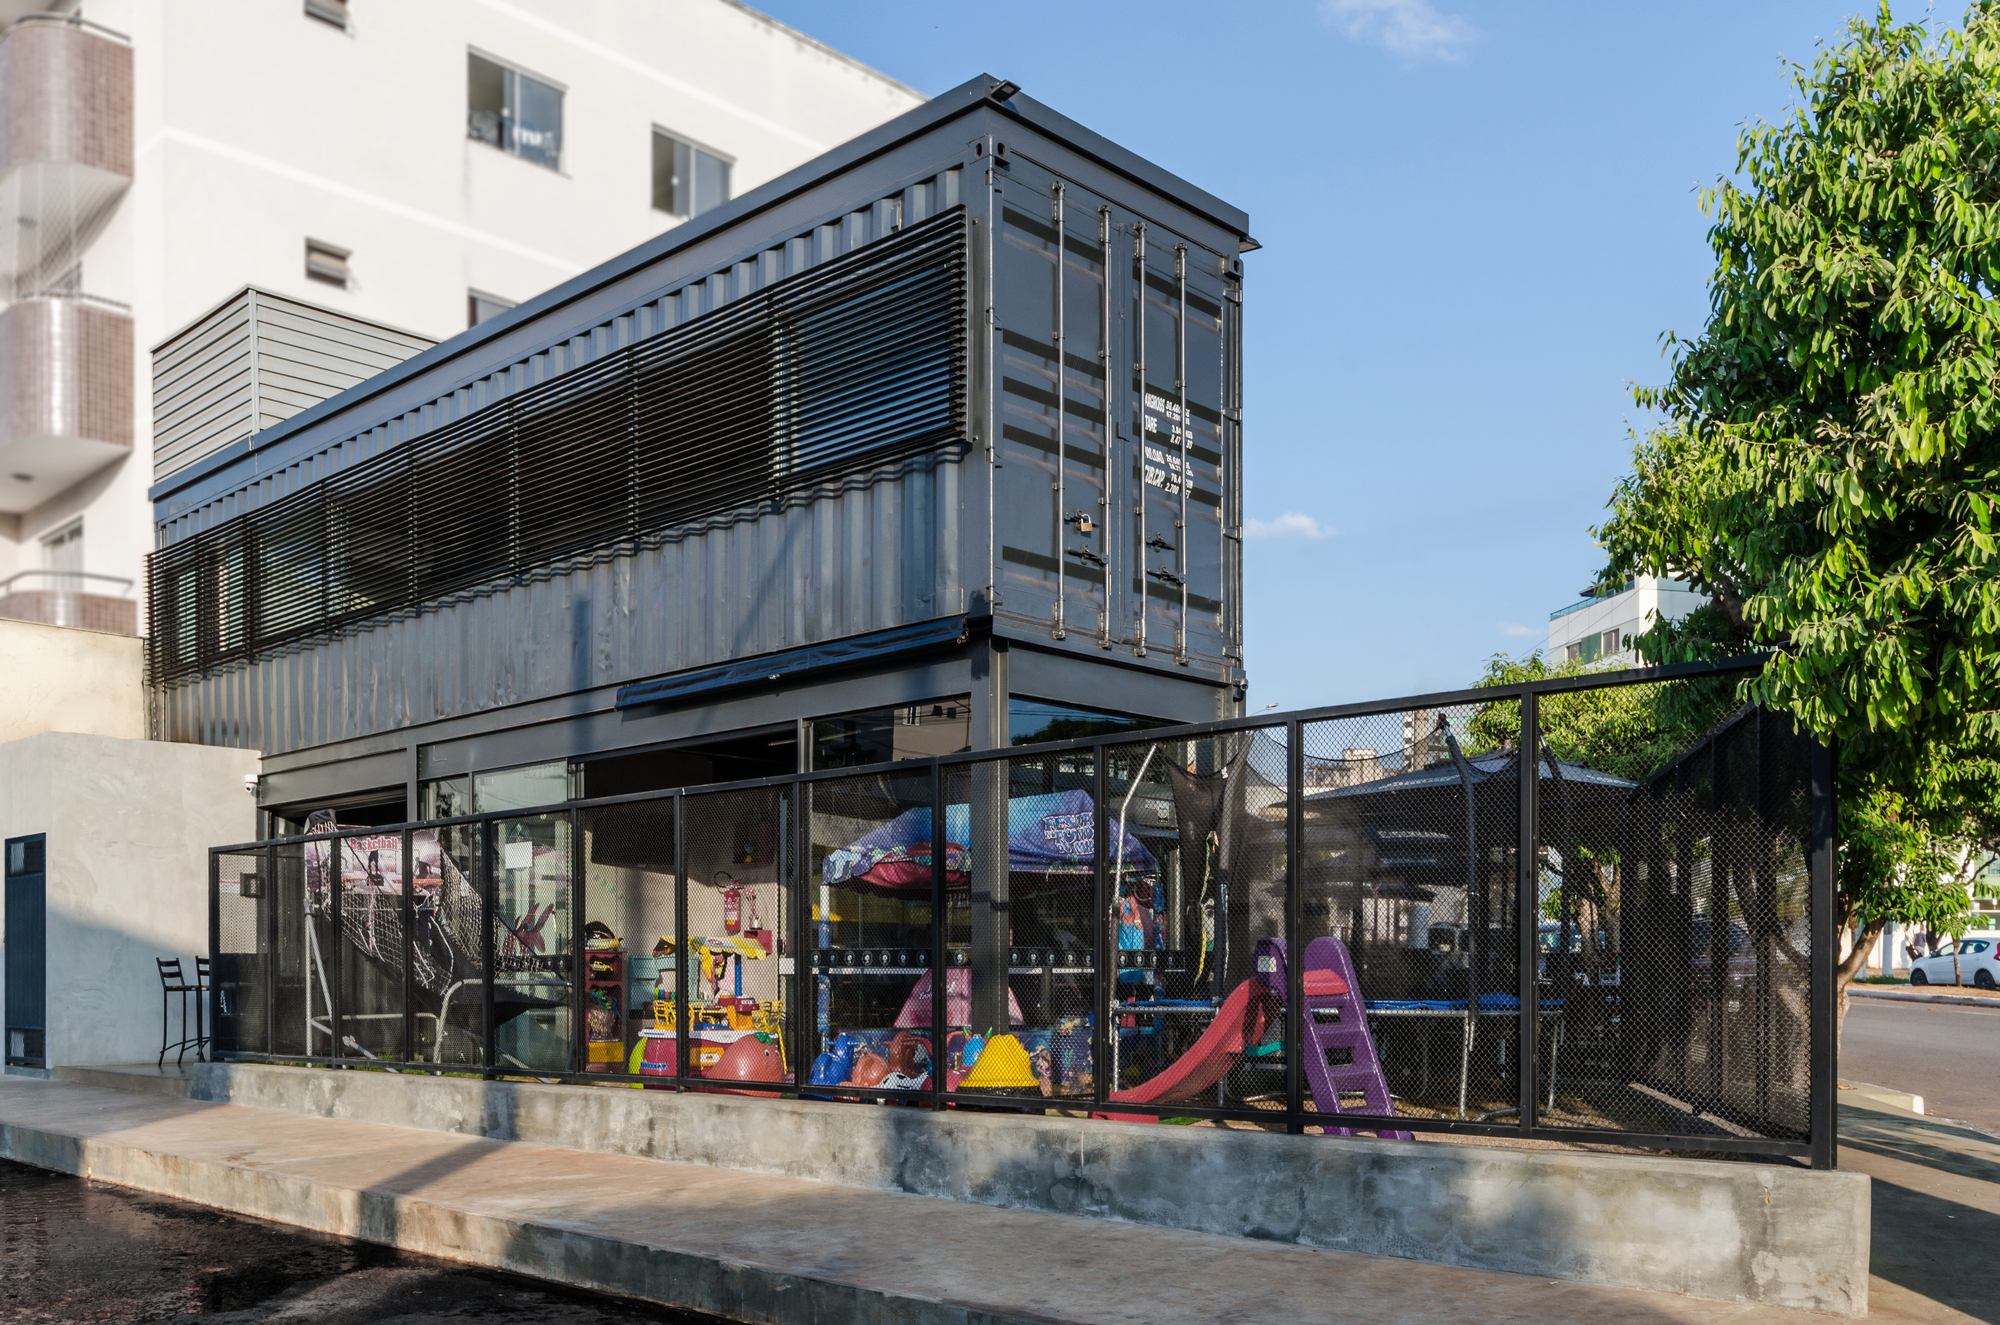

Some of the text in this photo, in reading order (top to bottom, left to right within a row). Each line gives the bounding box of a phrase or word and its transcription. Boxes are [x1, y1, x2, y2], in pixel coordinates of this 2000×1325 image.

[1145, 414, 1158, 434] TARE
[1042, 811, 1094, 831] FESTA
[350, 836, 398, 851] Basketball
[1055, 826, 1094, 844] FUND
[1073, 839, 1094, 855] MA
